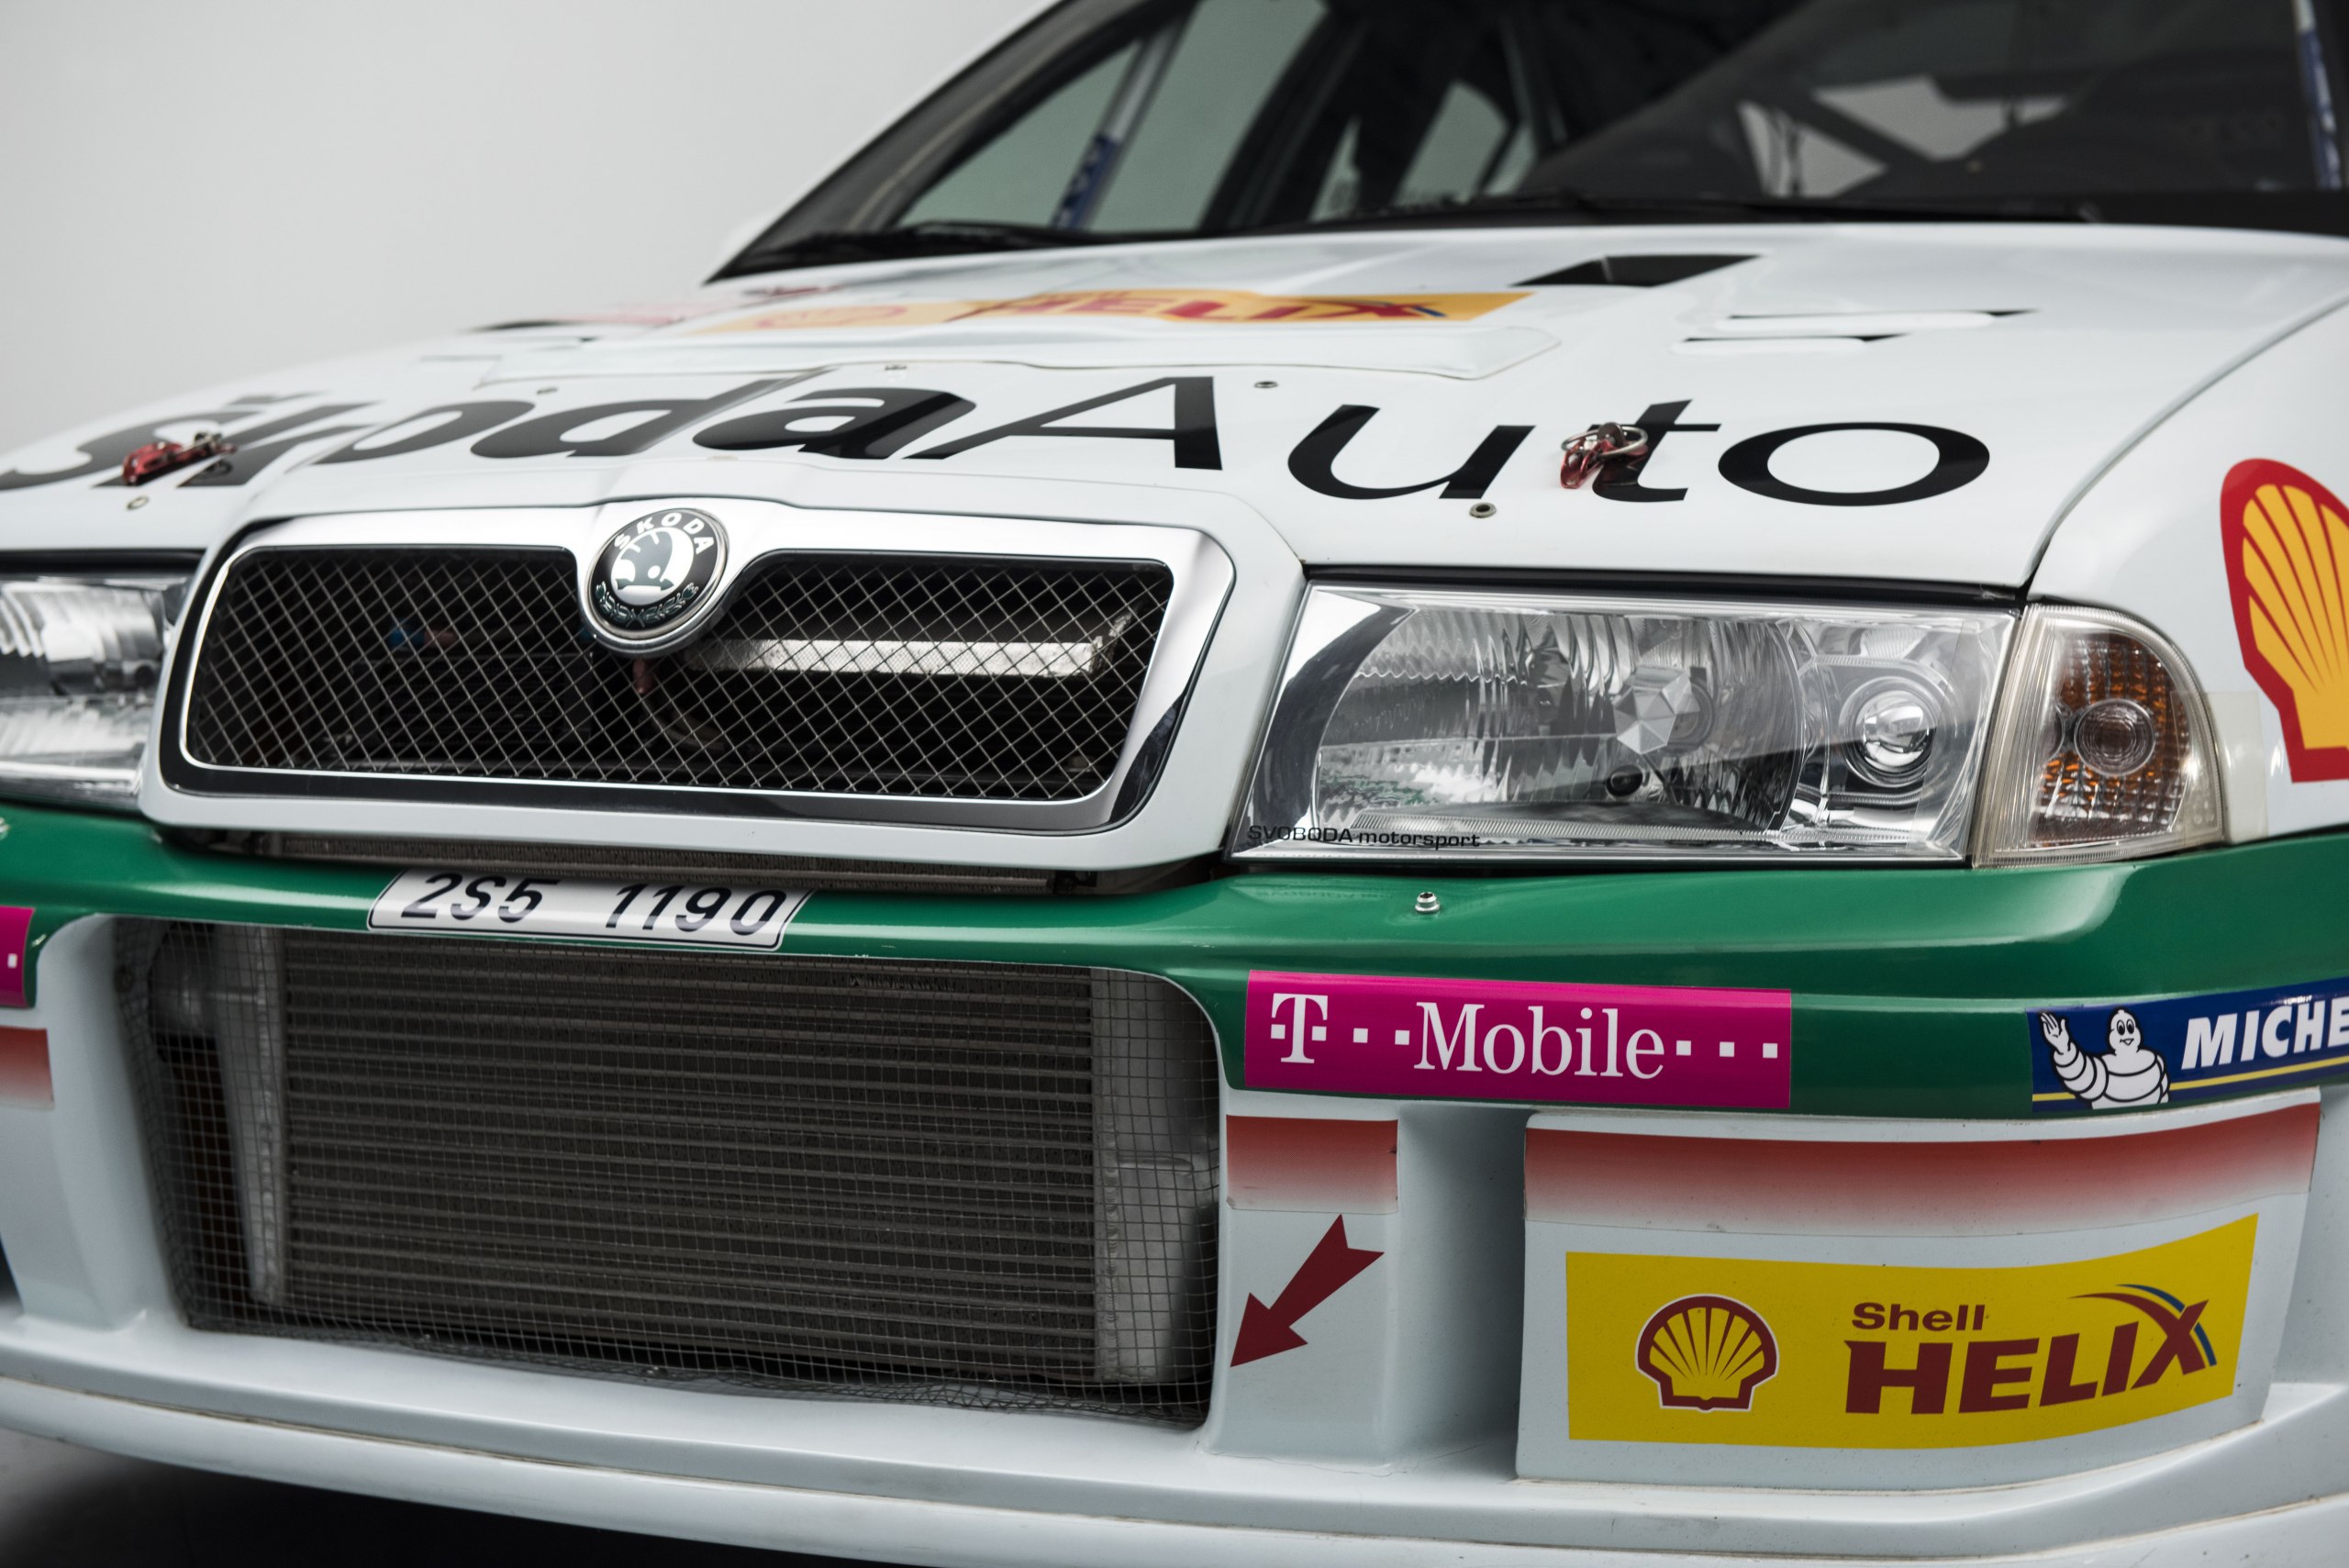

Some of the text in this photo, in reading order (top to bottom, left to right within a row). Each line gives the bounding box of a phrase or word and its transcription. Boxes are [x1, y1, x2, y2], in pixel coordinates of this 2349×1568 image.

[1248, 825, 1481, 851] SVOBODA motorsport
[400, 872, 788, 937] 2S5 1190
[1413, 1001, 1665, 1080] Mobile
[2180, 996, 2349, 1071] MICHE
[1852, 1302, 1986, 1331] Shell
[1843, 1297, 2210, 1415] HELIX
